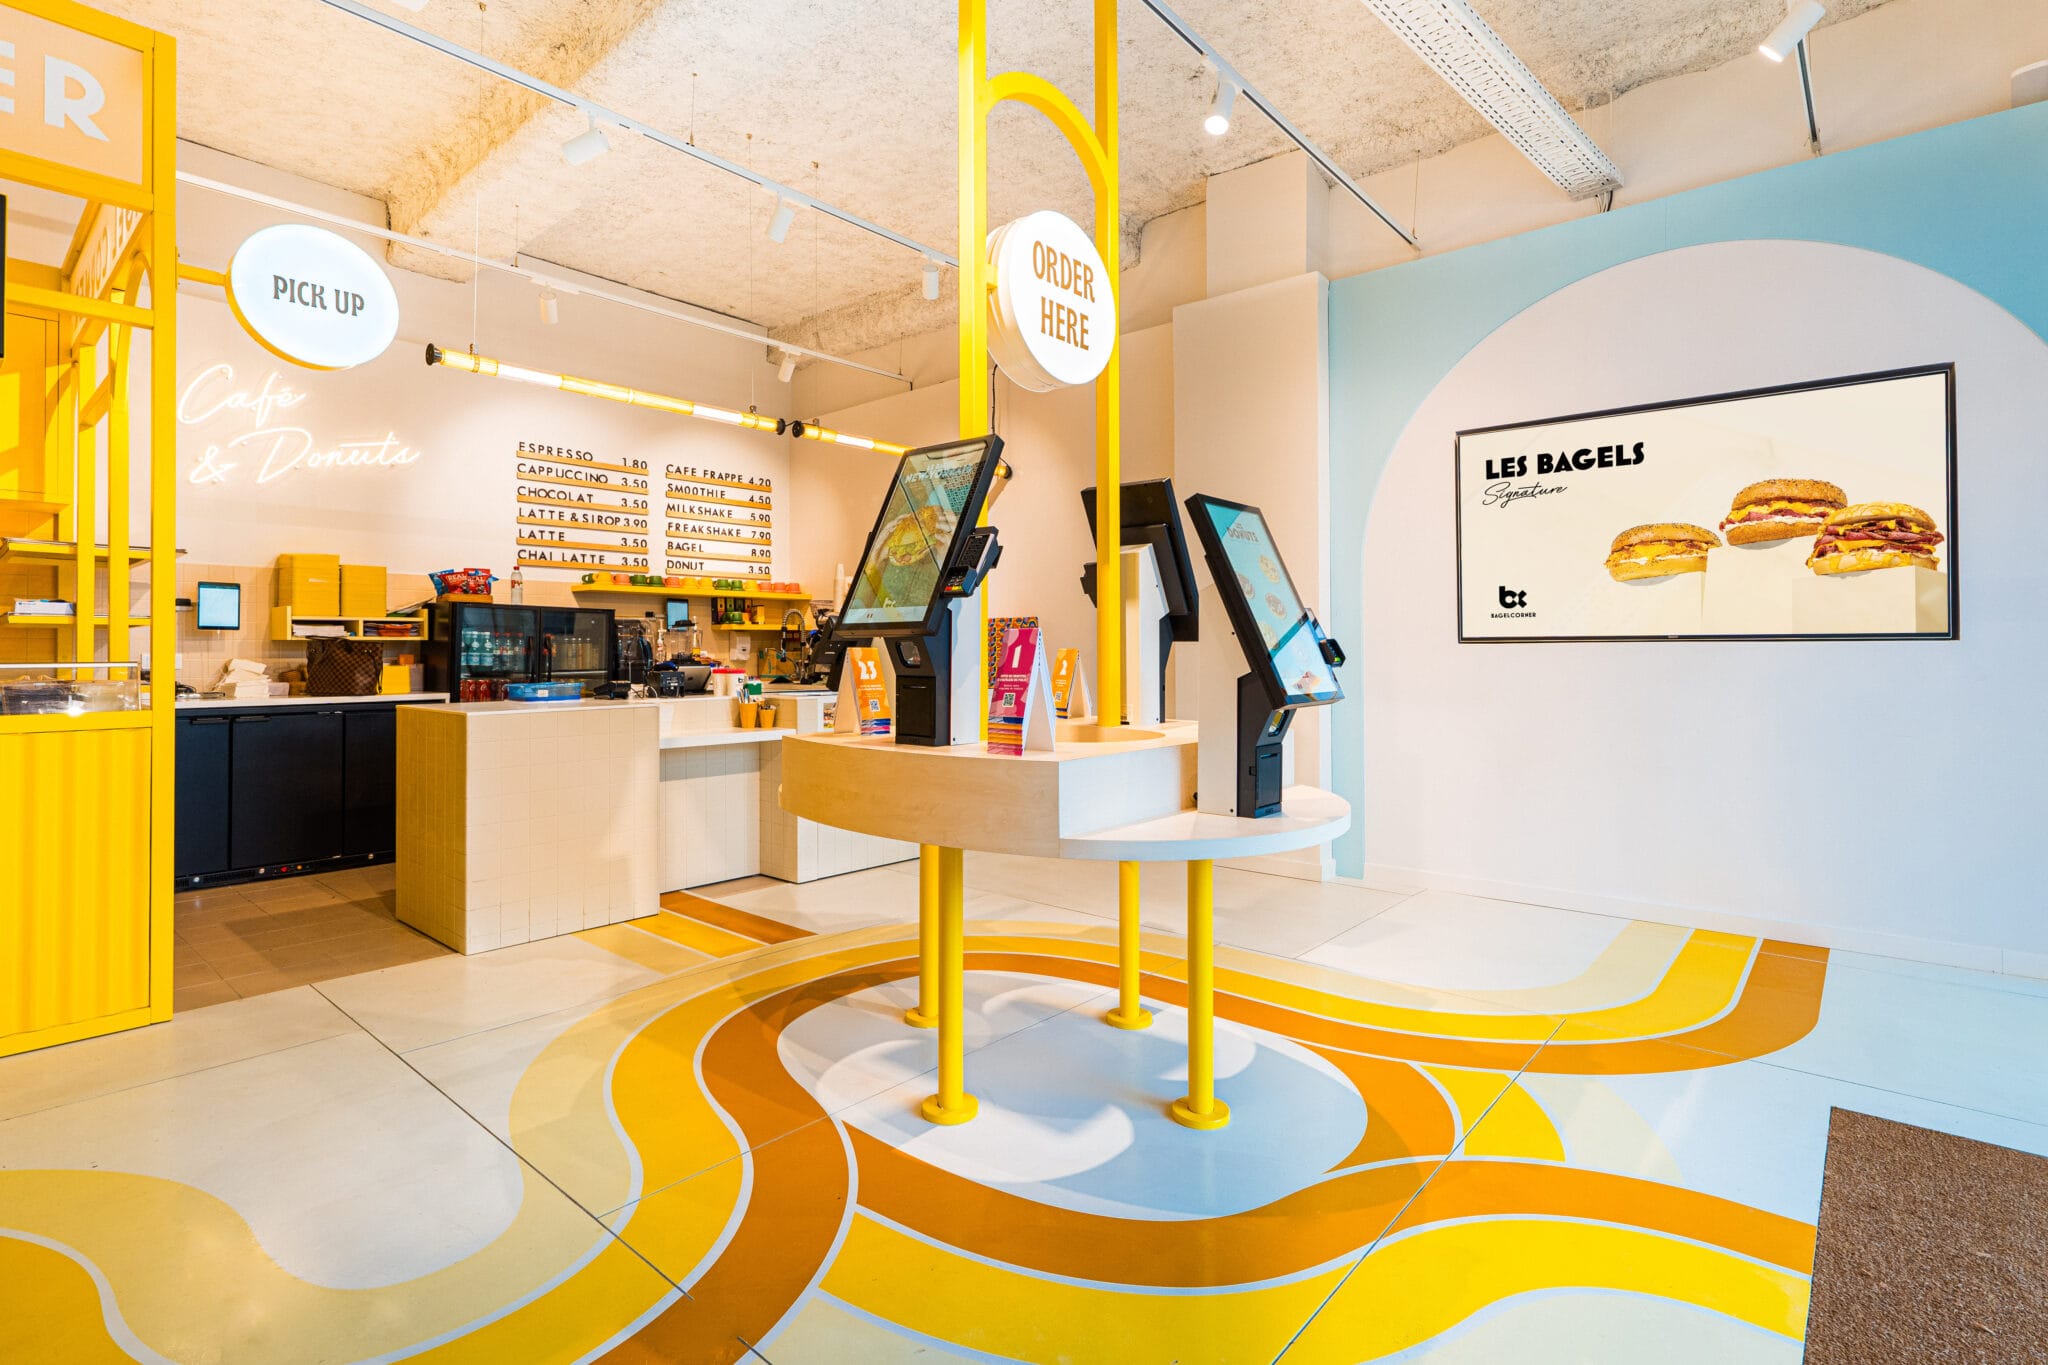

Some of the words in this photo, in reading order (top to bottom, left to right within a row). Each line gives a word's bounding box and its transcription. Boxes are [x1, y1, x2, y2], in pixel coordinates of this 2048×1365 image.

[1033, 240, 1096, 303] ORDER
[273, 274, 328, 311] PICK
[334, 288, 365, 316] UP
[1041, 296, 1090, 351] HERE
[177, 363, 307, 428] Café
[189, 445, 238, 484] &
[228, 426, 421, 484] Donuts
[519, 441, 594, 462] ESPRESSO
[622, 457, 648, 470] 1.80
[1485, 454, 1528, 480] LES
[1537, 441, 1645, 475] BAGELS
[517, 463, 609, 484] CAPPUCCINO
[621, 477, 648, 489] 3.50
[666, 463, 697, 477] CAFE
[703, 469, 743, 483] FRAPPE
[748, 476, 772, 488] 4.20
[517, 485, 594, 503] CHOCOLAT
[621, 497, 648, 510] 3.50
[667, 483, 727, 499] SMOOTHIE
[749, 495, 771, 505] 4.50
[1482, 481, 1568, 508] Signature
[518, 507, 566, 521] LATTE
[570, 512, 579, 523] &
[582, 513, 621, 526] SIROP
[623, 517, 648, 529] 3.90
[666, 503, 733, 519] MILKSHAKE
[750, 512, 771, 523] 5.90
[518, 528, 566, 542] LATTE
[620, 537, 648, 548] 3.50
[668, 521, 742, 538] FREAKSHAKE
[751, 530, 772, 541] 7.90
[517, 548, 553, 561] CHAI
[561, 552, 606, 565] LATTE
[621, 556, 649, 567] 3.50
[667, 541, 705, 553] BAGEL
[751, 548, 771, 558] 8.90
[667, 559, 705, 571] DONUT
[748, 565, 770, 575] 3.50
[1011, 644, 1022, 668] 1
[1059, 659, 1068, 676] 2
[858, 660, 877, 680] 23
